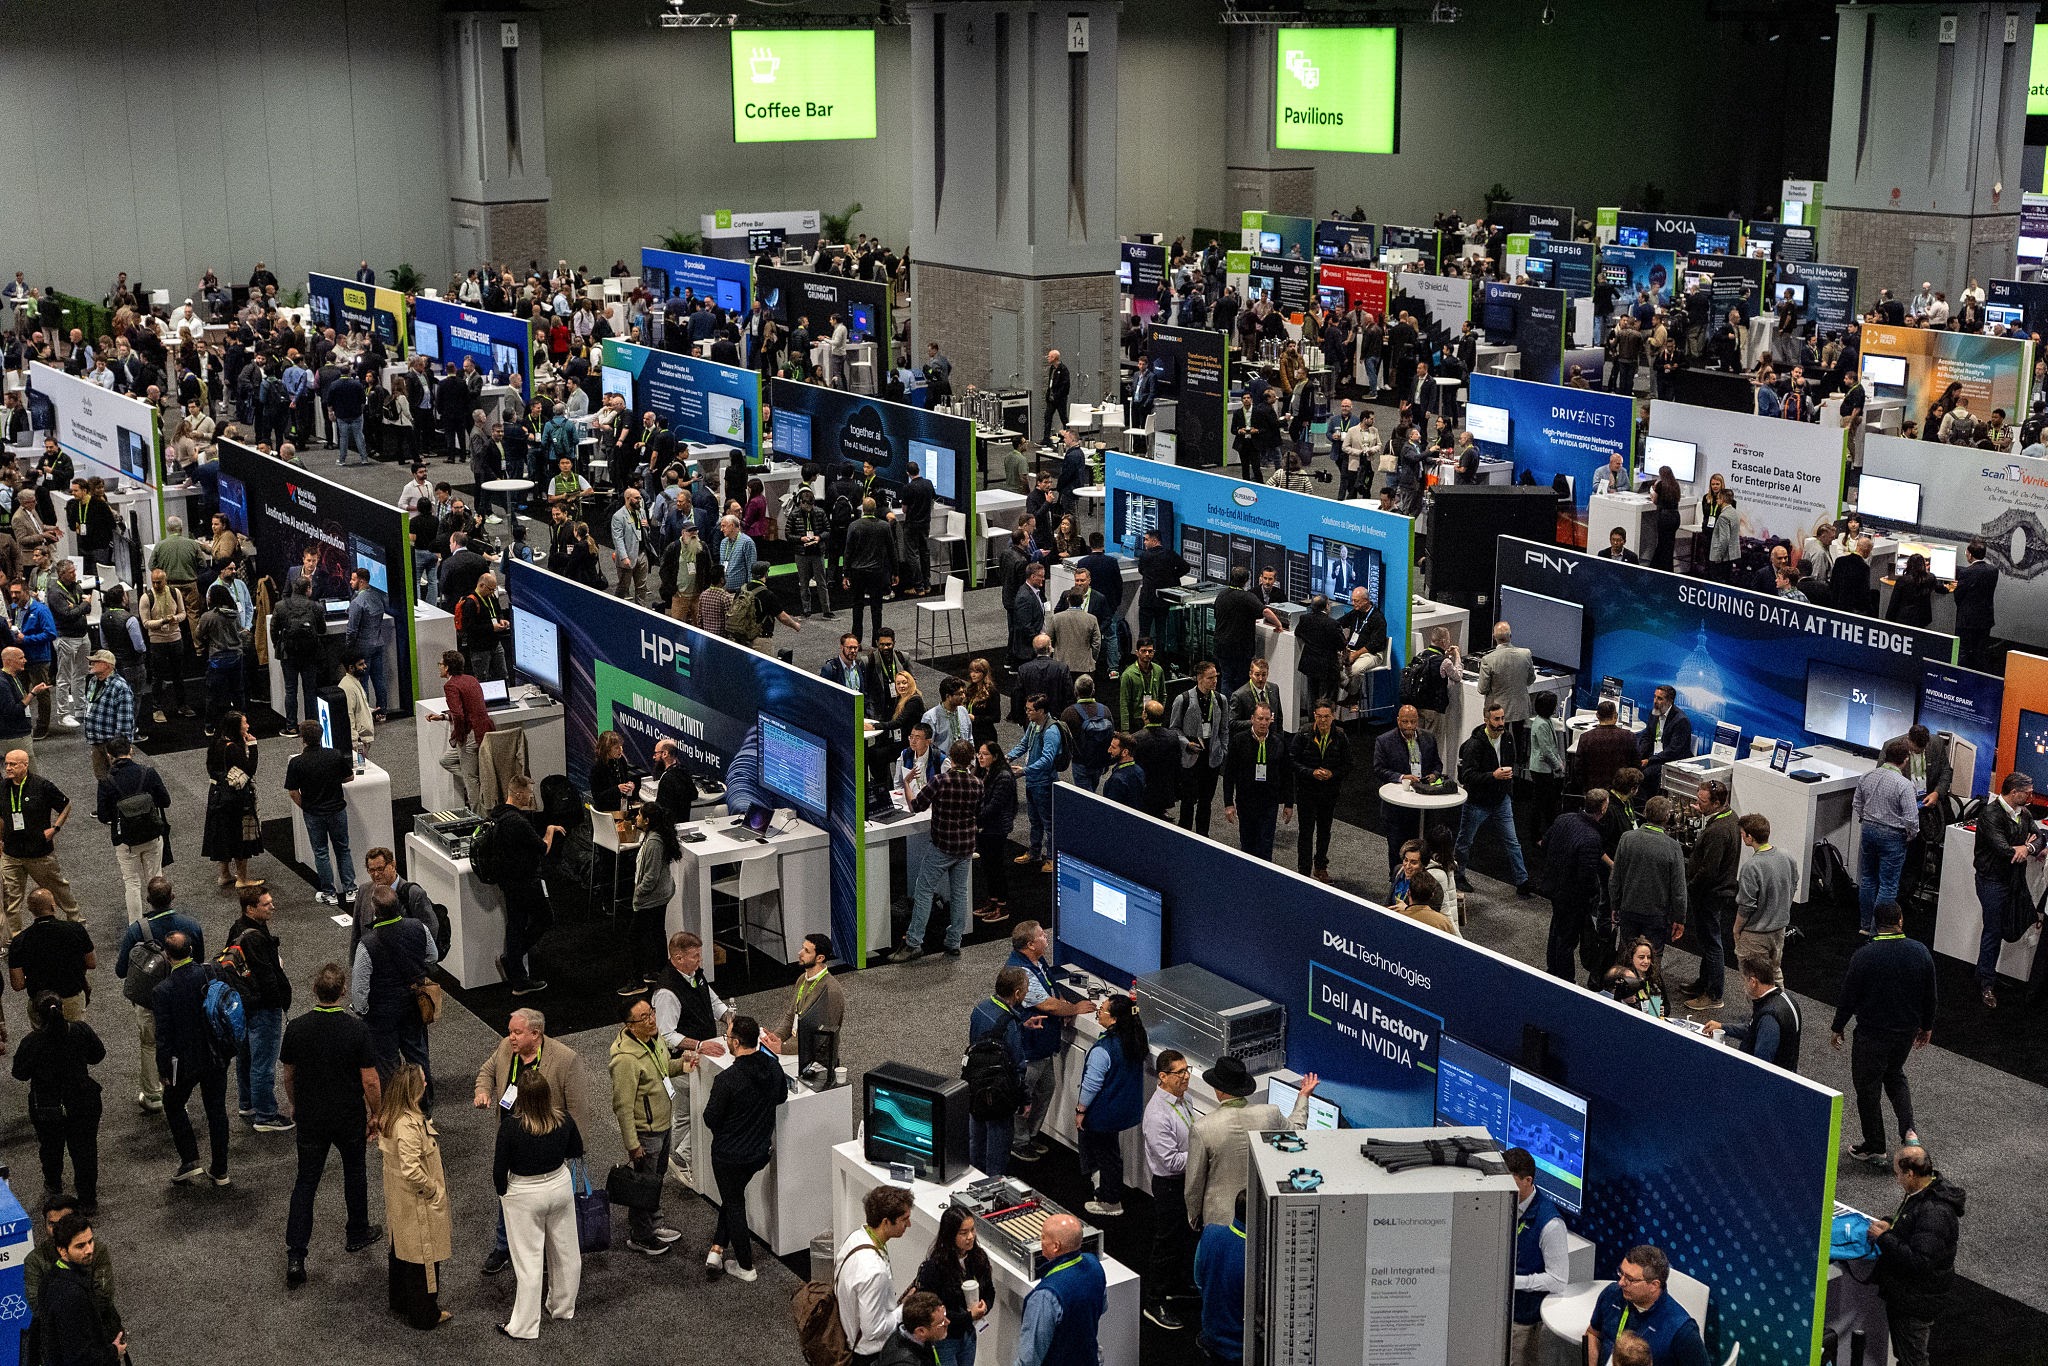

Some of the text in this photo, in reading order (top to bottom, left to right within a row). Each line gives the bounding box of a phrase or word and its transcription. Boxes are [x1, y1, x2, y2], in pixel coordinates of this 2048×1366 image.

[506, 26, 513, 34] A
[1074, 22, 1082, 32] A
[1073, 36, 1084, 48] 14
[745, 102, 834, 118] Coffee Bar
[1284, 107, 1344, 126] Pavilions
[802, 220, 816, 228] aws
[1538, 216, 1559, 226] Lambda
[1656, 220, 1696, 234] NOKIA
[1130, 247, 1146, 257] QuEra
[1548, 245, 1582, 255] DEEPSIG
[688, 261, 706, 270] poolside
[1260, 262, 1284, 272] Embedded
[1698, 260, 1723, 268] KEYSIGHT
[1796, 265, 1848, 278] Tiami Networks
[804, 282, 829, 292] NORTHROP
[1425, 281, 1448, 292] Shield AI
[1995, 286, 2010, 296] SHI
[808, 291, 834, 302] GRUMMAN
[1499, 290, 1522, 300] luminary
[464, 313, 478, 324] NetApp
[661, 362, 685, 373] VMware Private
[1938, 358, 1990, 370] Accelerate Innovation
[657, 368, 674, 378] Foundation
[681, 374, 694, 382] NVIDIA
[720, 370, 738, 380] vmware
[1949, 366, 1964, 374] Digital
[1965, 368, 1984, 376] Realty's
[1937, 372, 1959, 380] AI-Ready
[1972, 376, 1991, 384] Centers
[850, 424, 881, 441] together.ai
[1542, 428, 1623, 450] High-Performance Networking
[844, 439, 888, 457] The AI Native Cloud
[1550, 436, 1558, 444] for
[1559, 439, 1577, 448] NVIDIA
[1591, 444, 1614, 454] Clusters
[1732, 460, 1821, 484] Exascale Data Store
[1981, 468, 2005, 480] Scan
[1115, 468, 1130, 479] Solutions
[1135, 473, 1152, 485] Accelerate
[1157, 478, 1180, 490] Development
[1730, 473, 1802, 494] for Enterprise AI
[297, 486, 316, 502] World Wide
[1984, 486, 2008, 495] On-Press
[298, 496, 317, 514] Technology
[1208, 503, 1280, 529] End-to-End AI Infrastructure
[265, 503, 346, 551] Leading the AI and Digital Revolution
[1322, 515, 1340, 528] Solutions
[1346, 520, 1360, 534] Deploy
[1367, 525, 1386, 538] Inference
[1256, 529, 1281, 542] Manufacturing
[1525, 550, 1579, 574] PNY
[1678, 585, 1914, 656] SECURING DATA AT THE EDGE
[641, 629, 690, 677] HPE
[1852, 688, 1868, 705] 5x
[1926, 688, 1943, 698] NVIDIA
[1956, 696, 1973, 706] SPARK
[632, 692, 704, 740] UNLOCK PRODUCTIVITY
[620, 711, 720, 768] NVIDIA AI by HPE
[1323, 930, 1431, 989] DELL Technologies
[1322, 984, 1429, 1051] Dell AI Factory
[1337, 1022, 1411, 1069] WITH NVIDIA
[1373, 1218, 1446, 1226] DELL Technologies
[1371, 1266, 1435, 1276] Dell Integrated
[1371, 1277, 1417, 1286] Rack 7000
